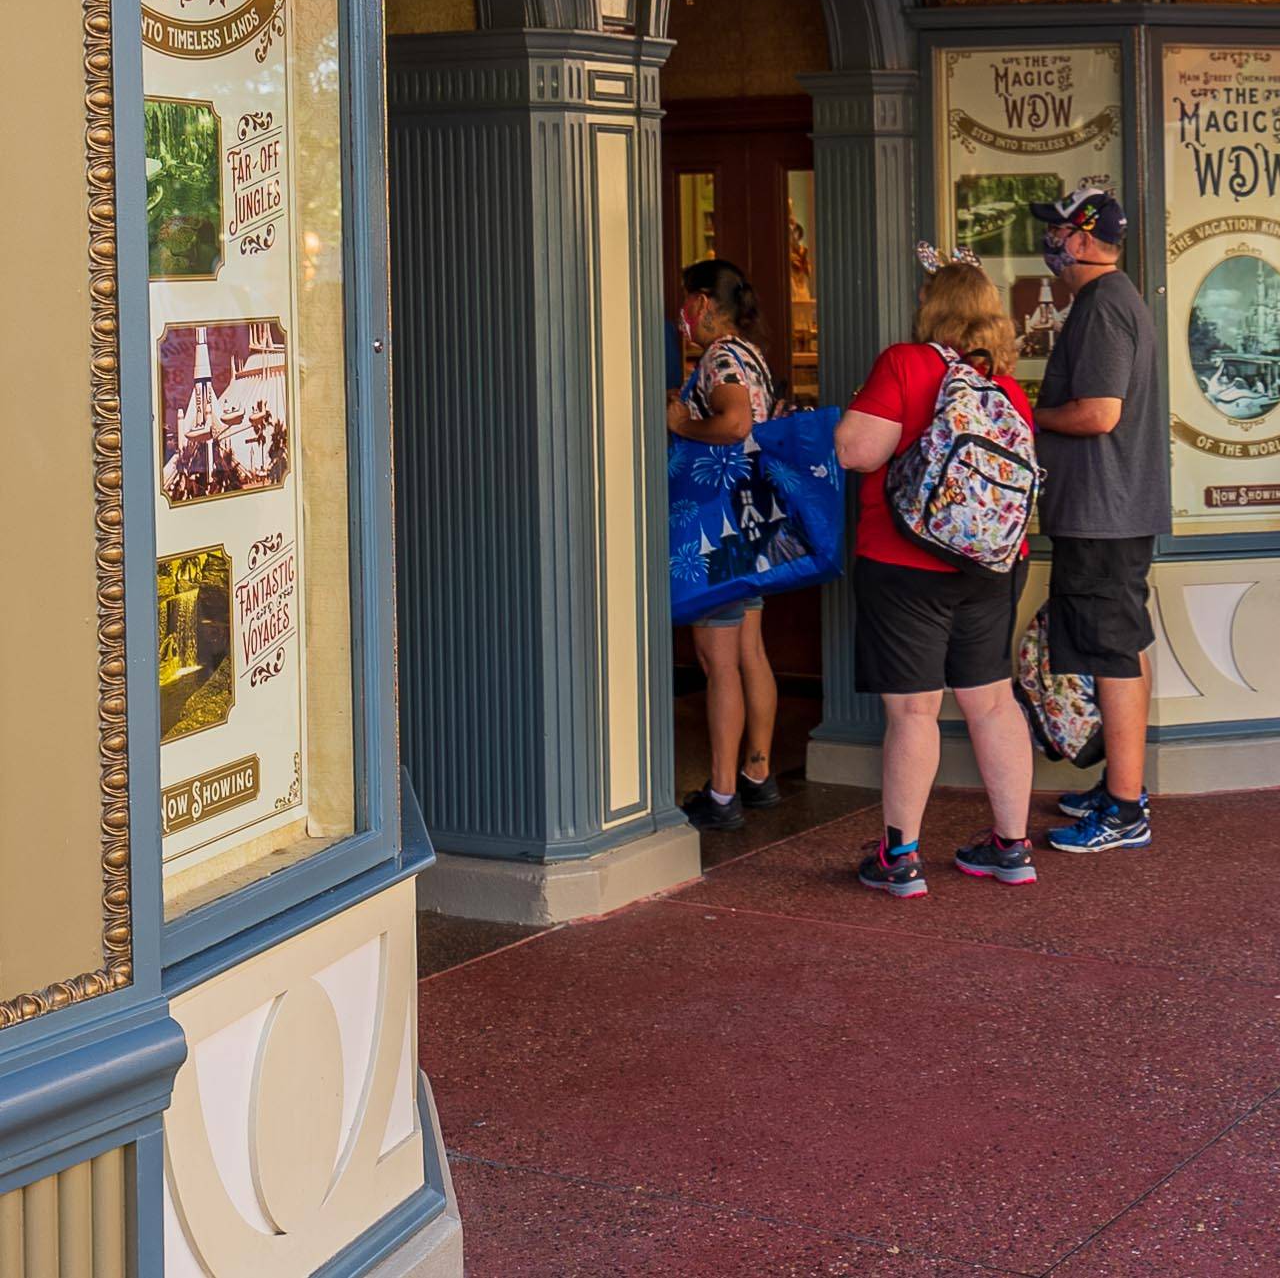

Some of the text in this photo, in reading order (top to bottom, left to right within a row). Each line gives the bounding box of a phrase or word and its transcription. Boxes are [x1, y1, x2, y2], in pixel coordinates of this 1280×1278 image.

[167, 26, 222, 50] TIMELESS
[223, 7, 261, 45] LANDS
[990, 64, 1054, 96] MAGIC
[1024, 56, 1048, 67] THE
[998, 92, 1073, 131] WDW
[1223, 88, 1259, 105] THE
[971, 125, 994, 144] STEP
[1021, 138, 1065, 151] TIMELESS
[1173, 97, 1268, 148] MAGIC
[227, 140, 280, 193] FAR-OFF
[229, 179, 282, 237] JUNGLES
[1170, 233, 1194, 255] THE
[1195, 219, 1257, 238] VACATION
[1196, 436, 1213, 450] OF
[1218, 443, 1243, 456] THE
[1210, 488, 1238, 506] NOW
[235, 555, 294, 625] FANTASTIC
[242, 603, 290, 667] VOYAGES
[191, 768, 253, 821] SHOWING
